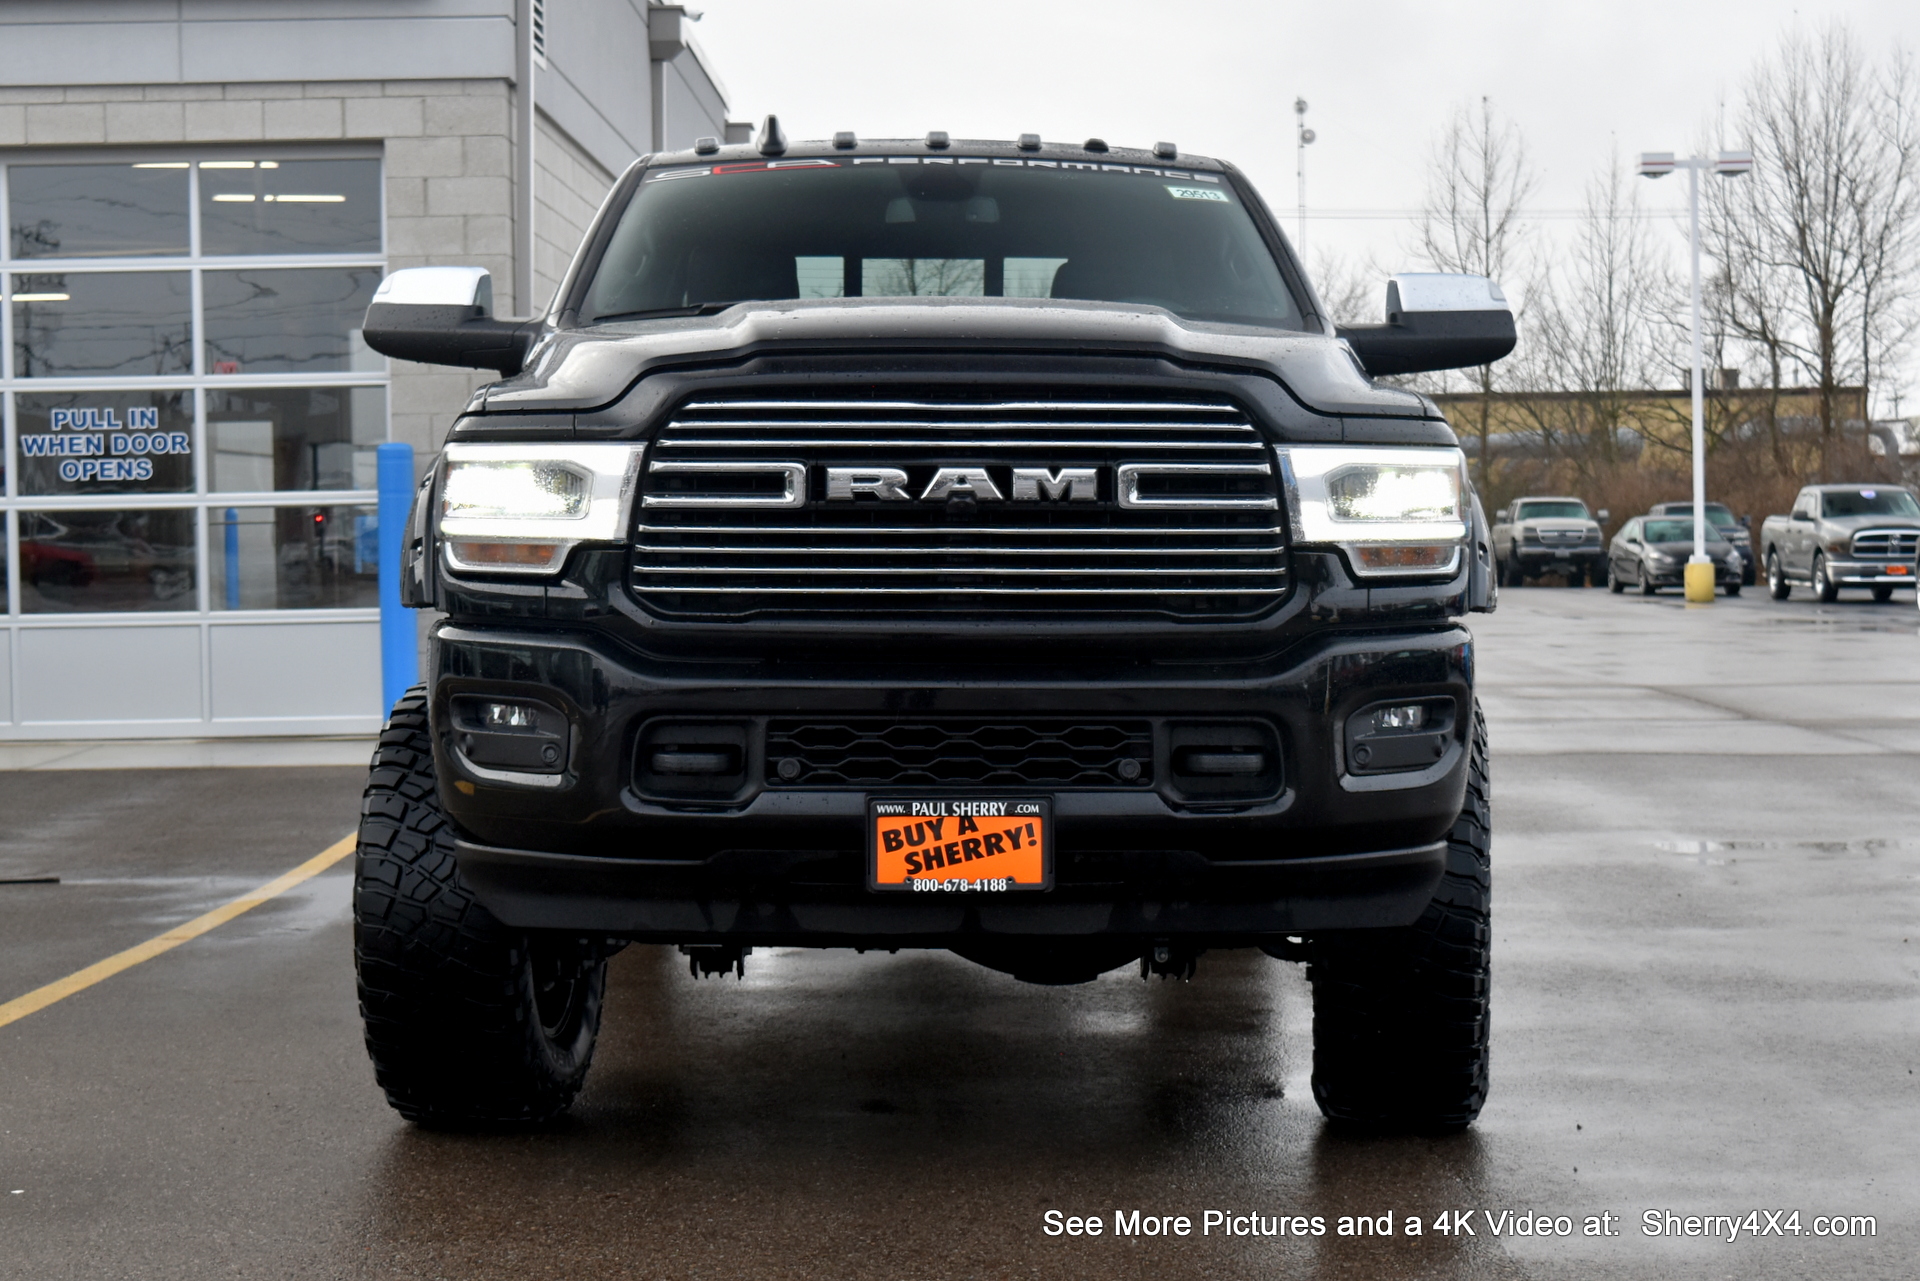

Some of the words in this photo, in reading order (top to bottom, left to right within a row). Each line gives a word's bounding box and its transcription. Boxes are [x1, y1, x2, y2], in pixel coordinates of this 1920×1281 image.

[1176, 188, 1221, 201] 29513
[51, 408, 122, 431] PULL
[128, 407, 158, 429] IN
[21, 433, 104, 456] WHEN
[110, 432, 190, 455] DOOR
[60, 458, 153, 481] OPENS
[826, 467, 1098, 499] RAM
[911, 802, 948, 816] PAUL
[952, 802, 1008, 816] SHERRY
[882, 817, 945, 853] BUY
[957, 816, 979, 836] A
[904, 822, 1038, 875] SHERRY!
[913, 878, 1007, 892] 800-678-4188
